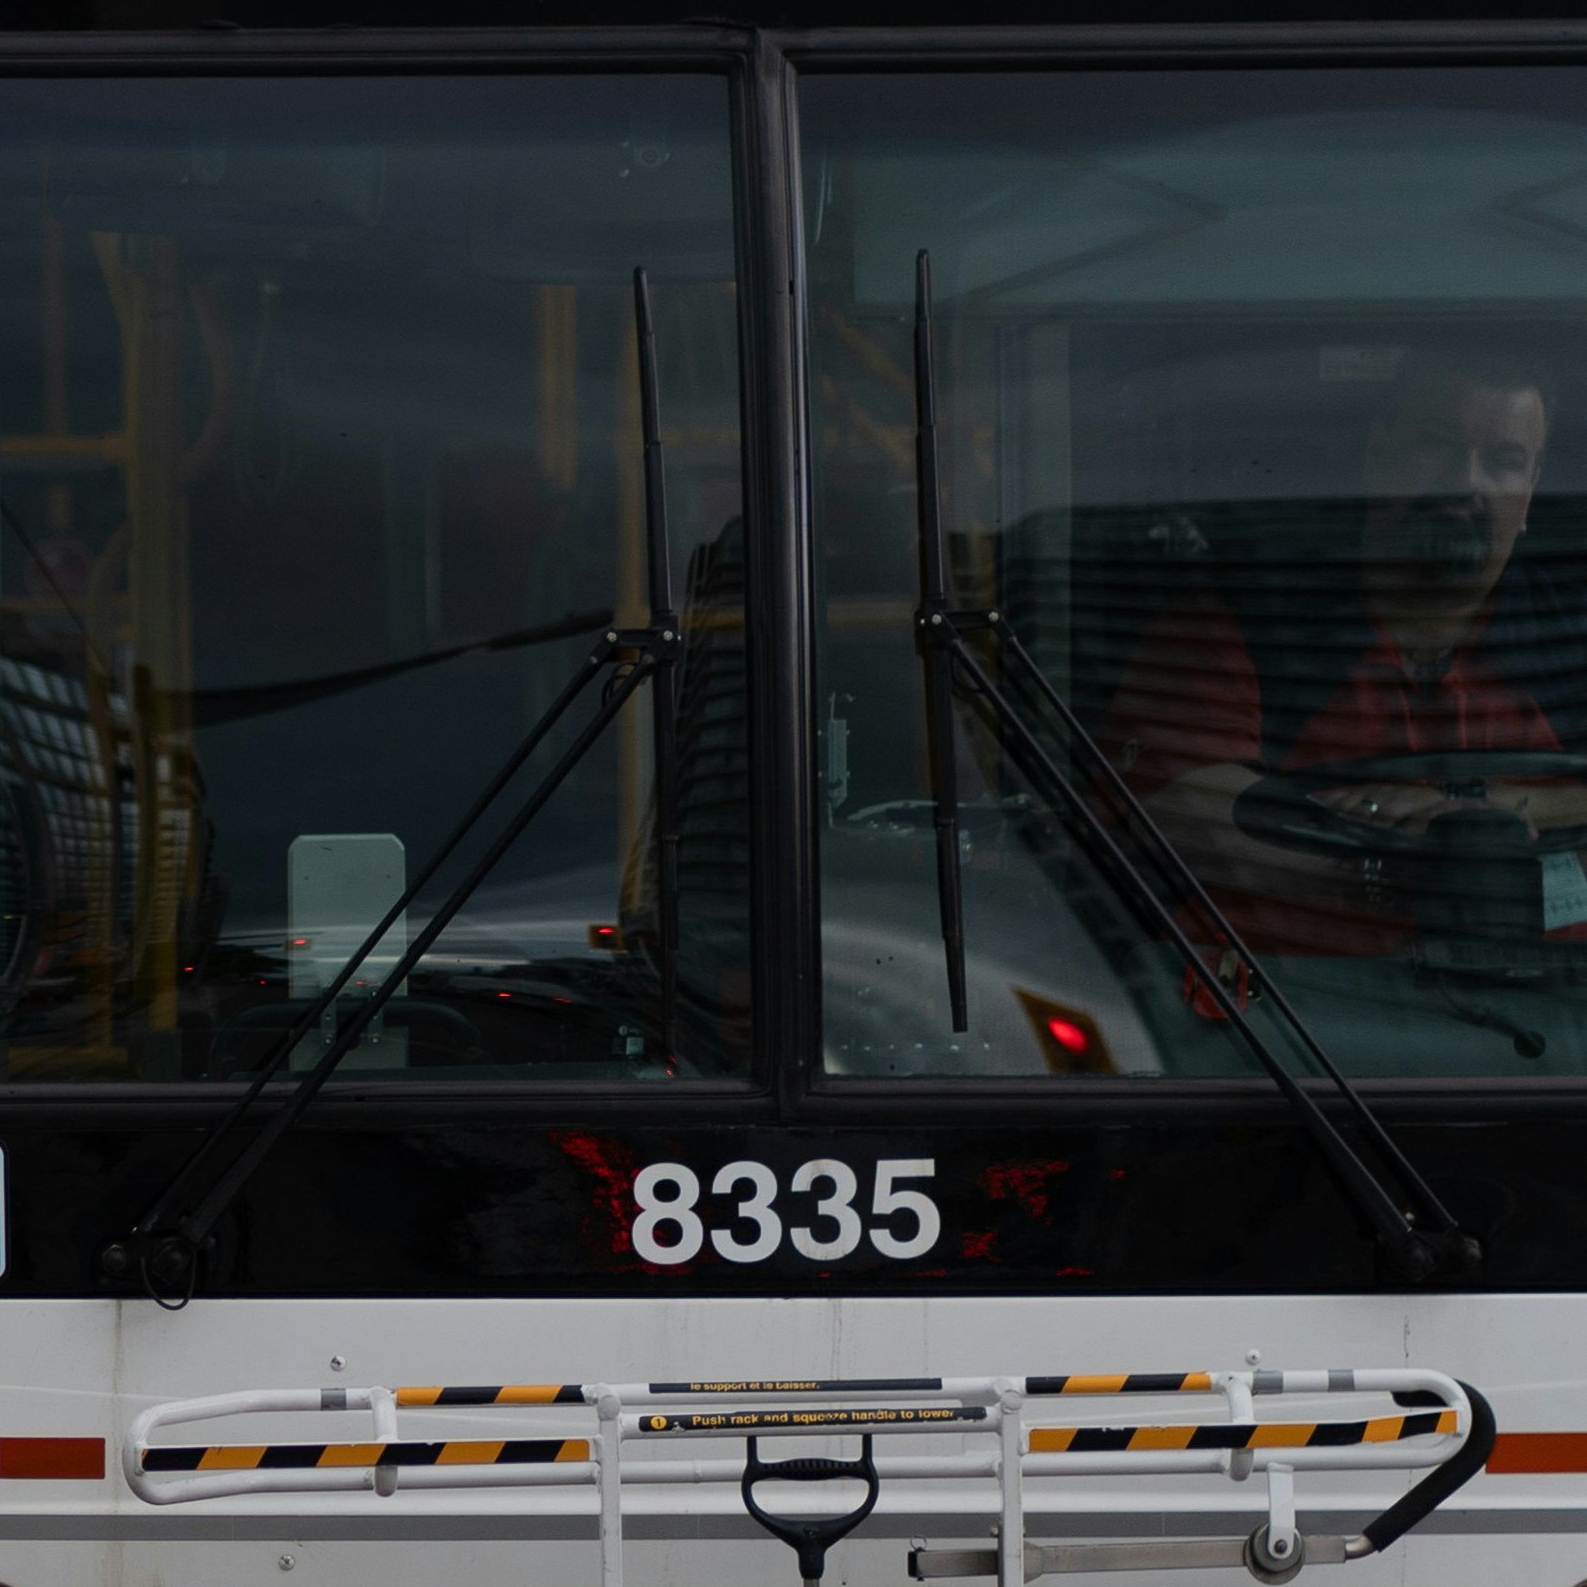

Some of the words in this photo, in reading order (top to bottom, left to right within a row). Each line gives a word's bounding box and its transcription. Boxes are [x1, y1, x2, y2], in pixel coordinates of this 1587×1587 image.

[631, 1158, 942, 1265] 8335
[704, 1382, 748, 1392] support
[692, 1415, 726, 1426] Push
[730, 1413, 759, 1425] rack
[851, 1409, 897, 1421] handle
[900, 1410, 914, 1420] to
